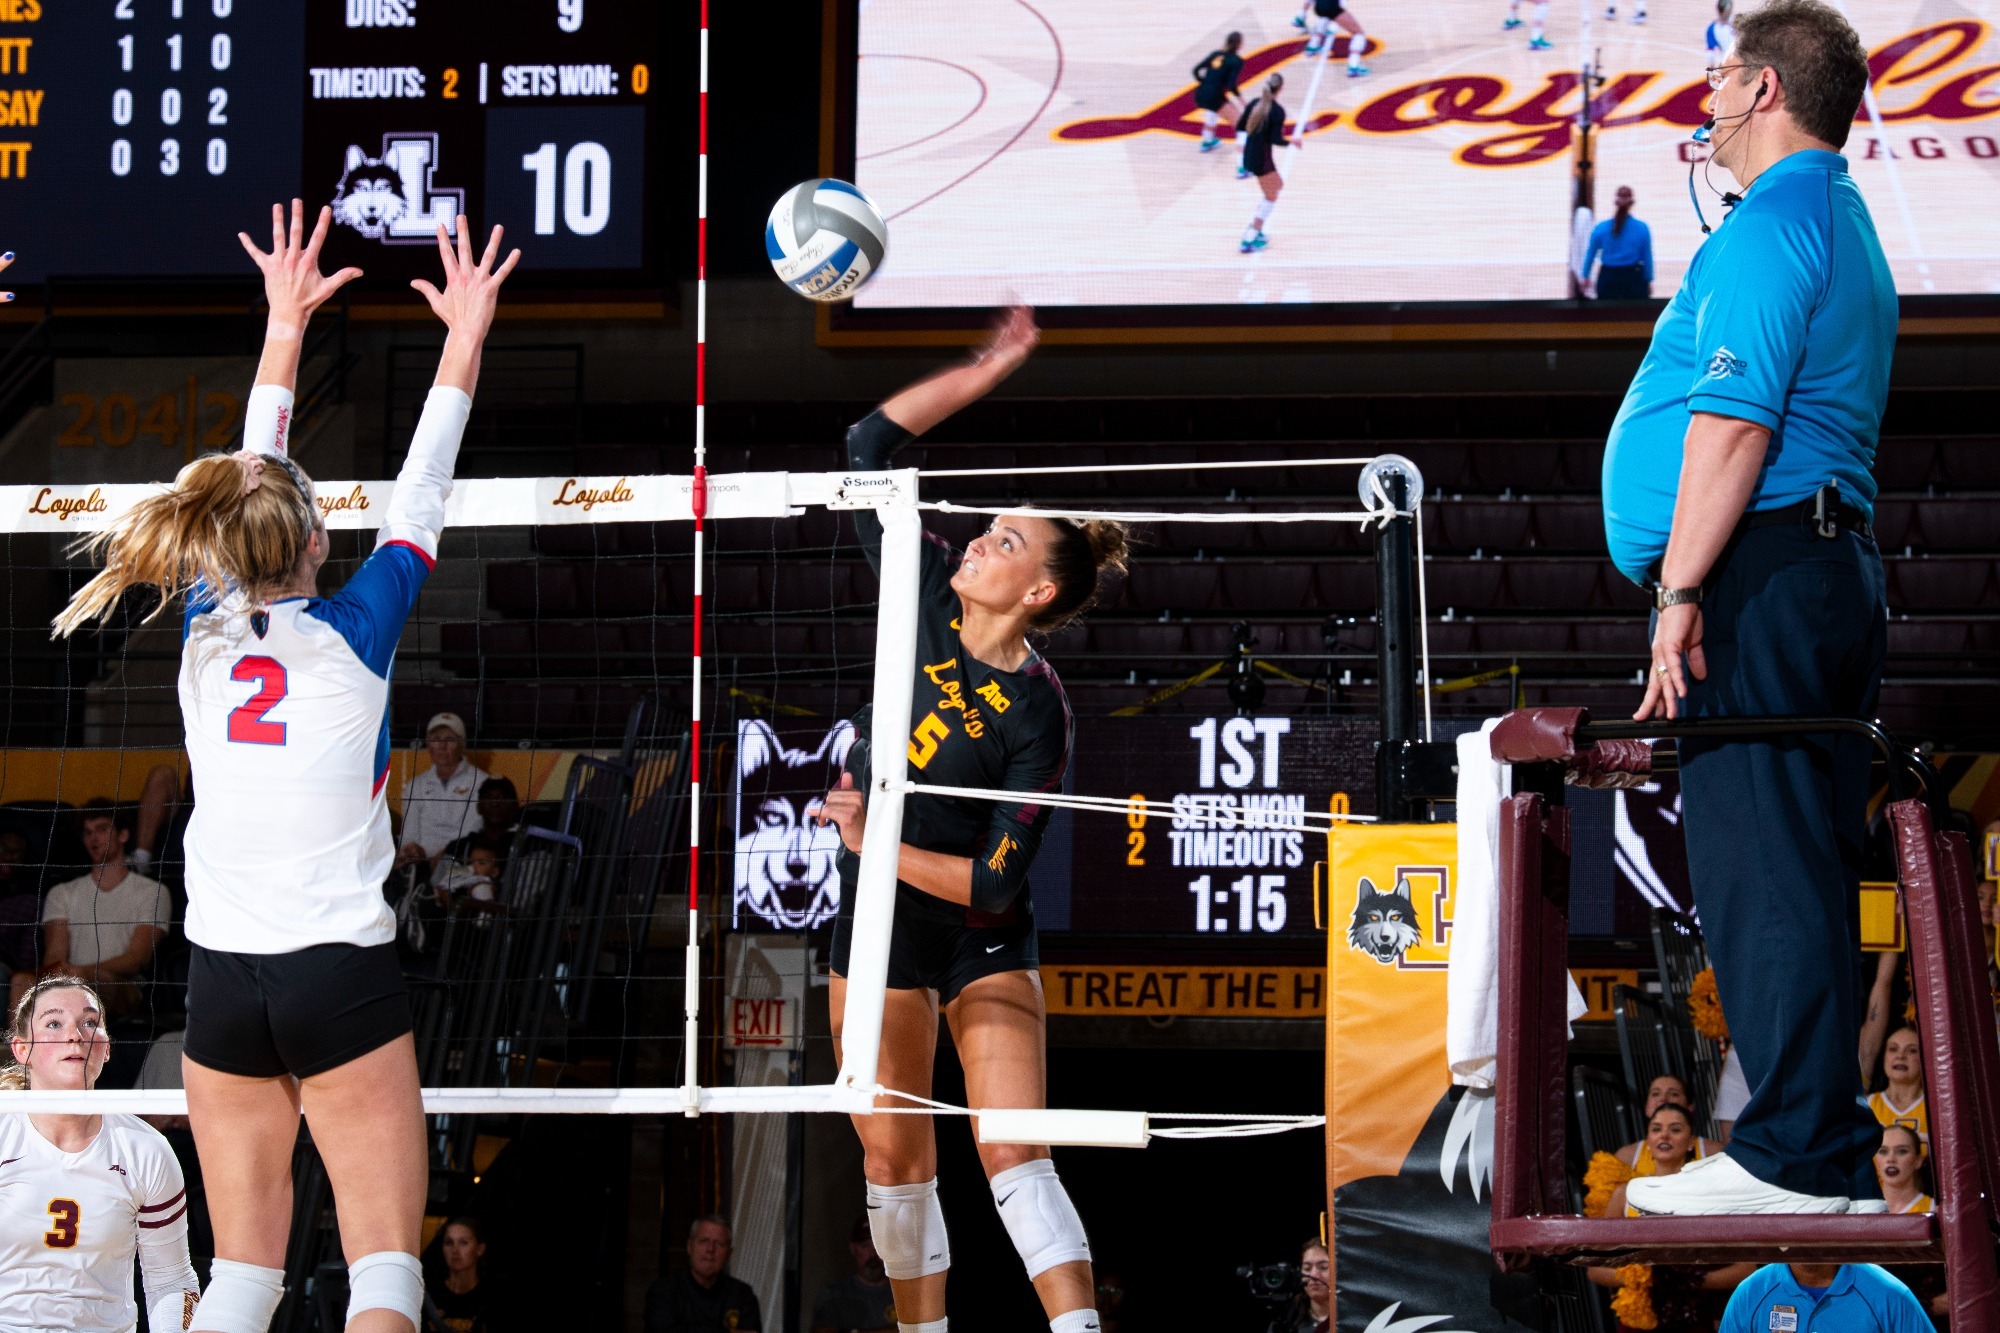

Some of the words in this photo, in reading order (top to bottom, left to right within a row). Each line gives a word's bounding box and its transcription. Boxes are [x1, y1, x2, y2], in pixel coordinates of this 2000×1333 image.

[346, 0, 416, 27] DIGS:
[557, 0, 583, 32] 9
[117, 34, 134, 72] 1
[166, 34, 182, 71] 1
[211, 33, 231, 70] 0
[310, 66, 425, 98] TIMEOUTS:
[443, 68, 459, 99] 2
[501, 65, 556, 96] SETS
[558, 64, 619, 94] WON:
[631, 64, 649, 94] 0
[112, 89, 132, 126] 0
[161, 88, 181, 124] 0
[208, 88, 228, 125] 2
[111, 139, 131, 176] 0
[160, 139, 180, 176] 3
[207, 139, 227, 176] 0
[382, 132, 464, 244] L
[522, 141, 611, 235] 10
[274, 405, 289, 451] DEMONS
[552, 477, 634, 511] Loyola
[709, 484, 741, 494] imports
[854, 478, 893, 487] Senoh
[29, 487, 107, 520] Loyola
[228, 654, 288, 746] 2
[975, 679, 1011, 714] A10
[905, 711, 951, 770] 5
[1190, 717, 1290, 789] 1ST
[1127, 794, 1147, 830] 0
[1171, 793, 1238, 830] SETS
[1240, 794, 1305, 829] WON
[1127, 831, 1146, 867] 2
[1168, 831, 1304, 868] TIMEOUTS
[1188, 875, 1287, 932] 1:15
[1058, 971, 1187, 1008] TREAT
[1200, 973, 1277, 1009] THE
[734, 999, 786, 1035] EXIT
[44, 1197, 81, 1249] 3
